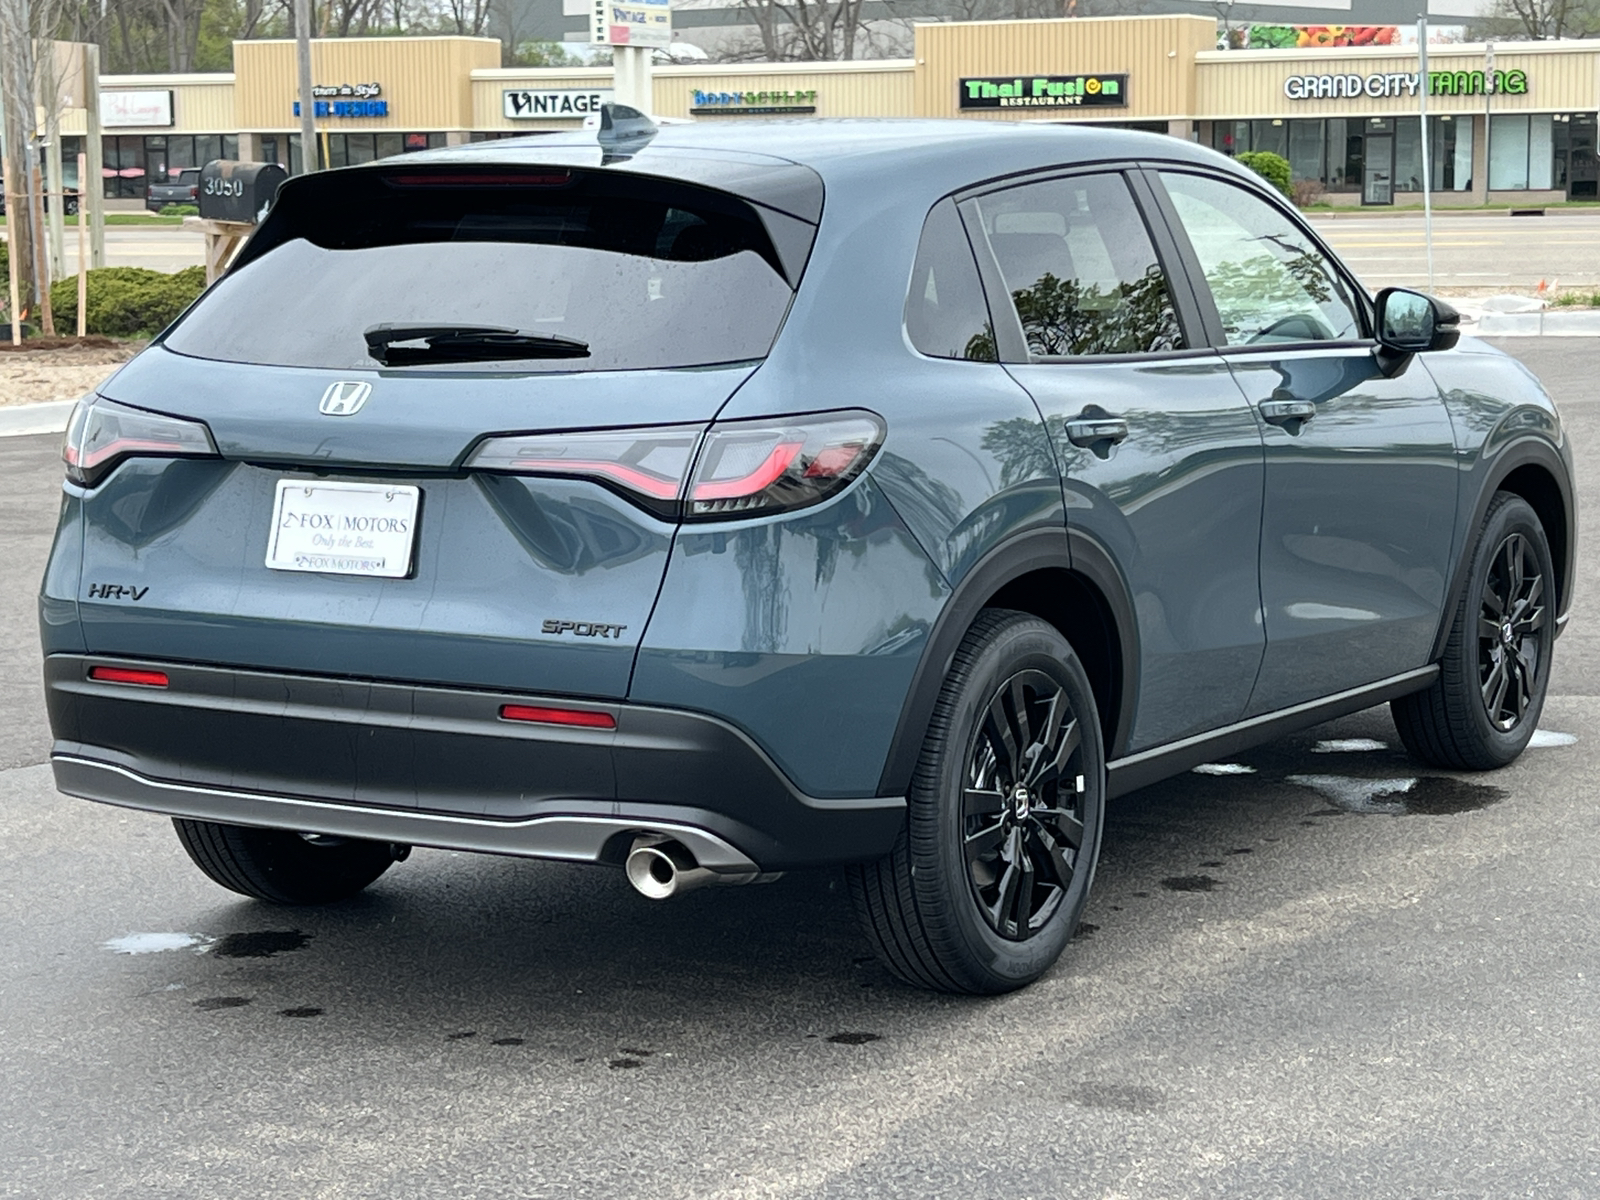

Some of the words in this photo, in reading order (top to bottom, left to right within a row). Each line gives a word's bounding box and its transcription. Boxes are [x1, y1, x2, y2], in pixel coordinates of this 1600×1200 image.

[965, 79, 1023, 99] Thai
[1032, 77, 1119, 97] Fusion
[1284, 76, 1362, 100] GRAND
[1364, 74, 1420, 98] CITY
[1427, 70, 1527, 96] TANNNG
[292, 101, 330, 117] HIR
[508, 92, 601, 116] VINTAGE
[1000, 97, 1083, 107] RESTAURANT
[204, 176, 243, 197] 3050
[300, 513, 335, 530] FOX
[343, 516, 409, 534] MOTORS
[312, 533, 337, 550] Only
[338, 534, 353, 548] the
[308, 557, 331, 569] FOX
[331, 558, 376, 572] MOTORS
[88, 583, 149, 601] HR-V
[541, 619, 628, 638] SPORT
